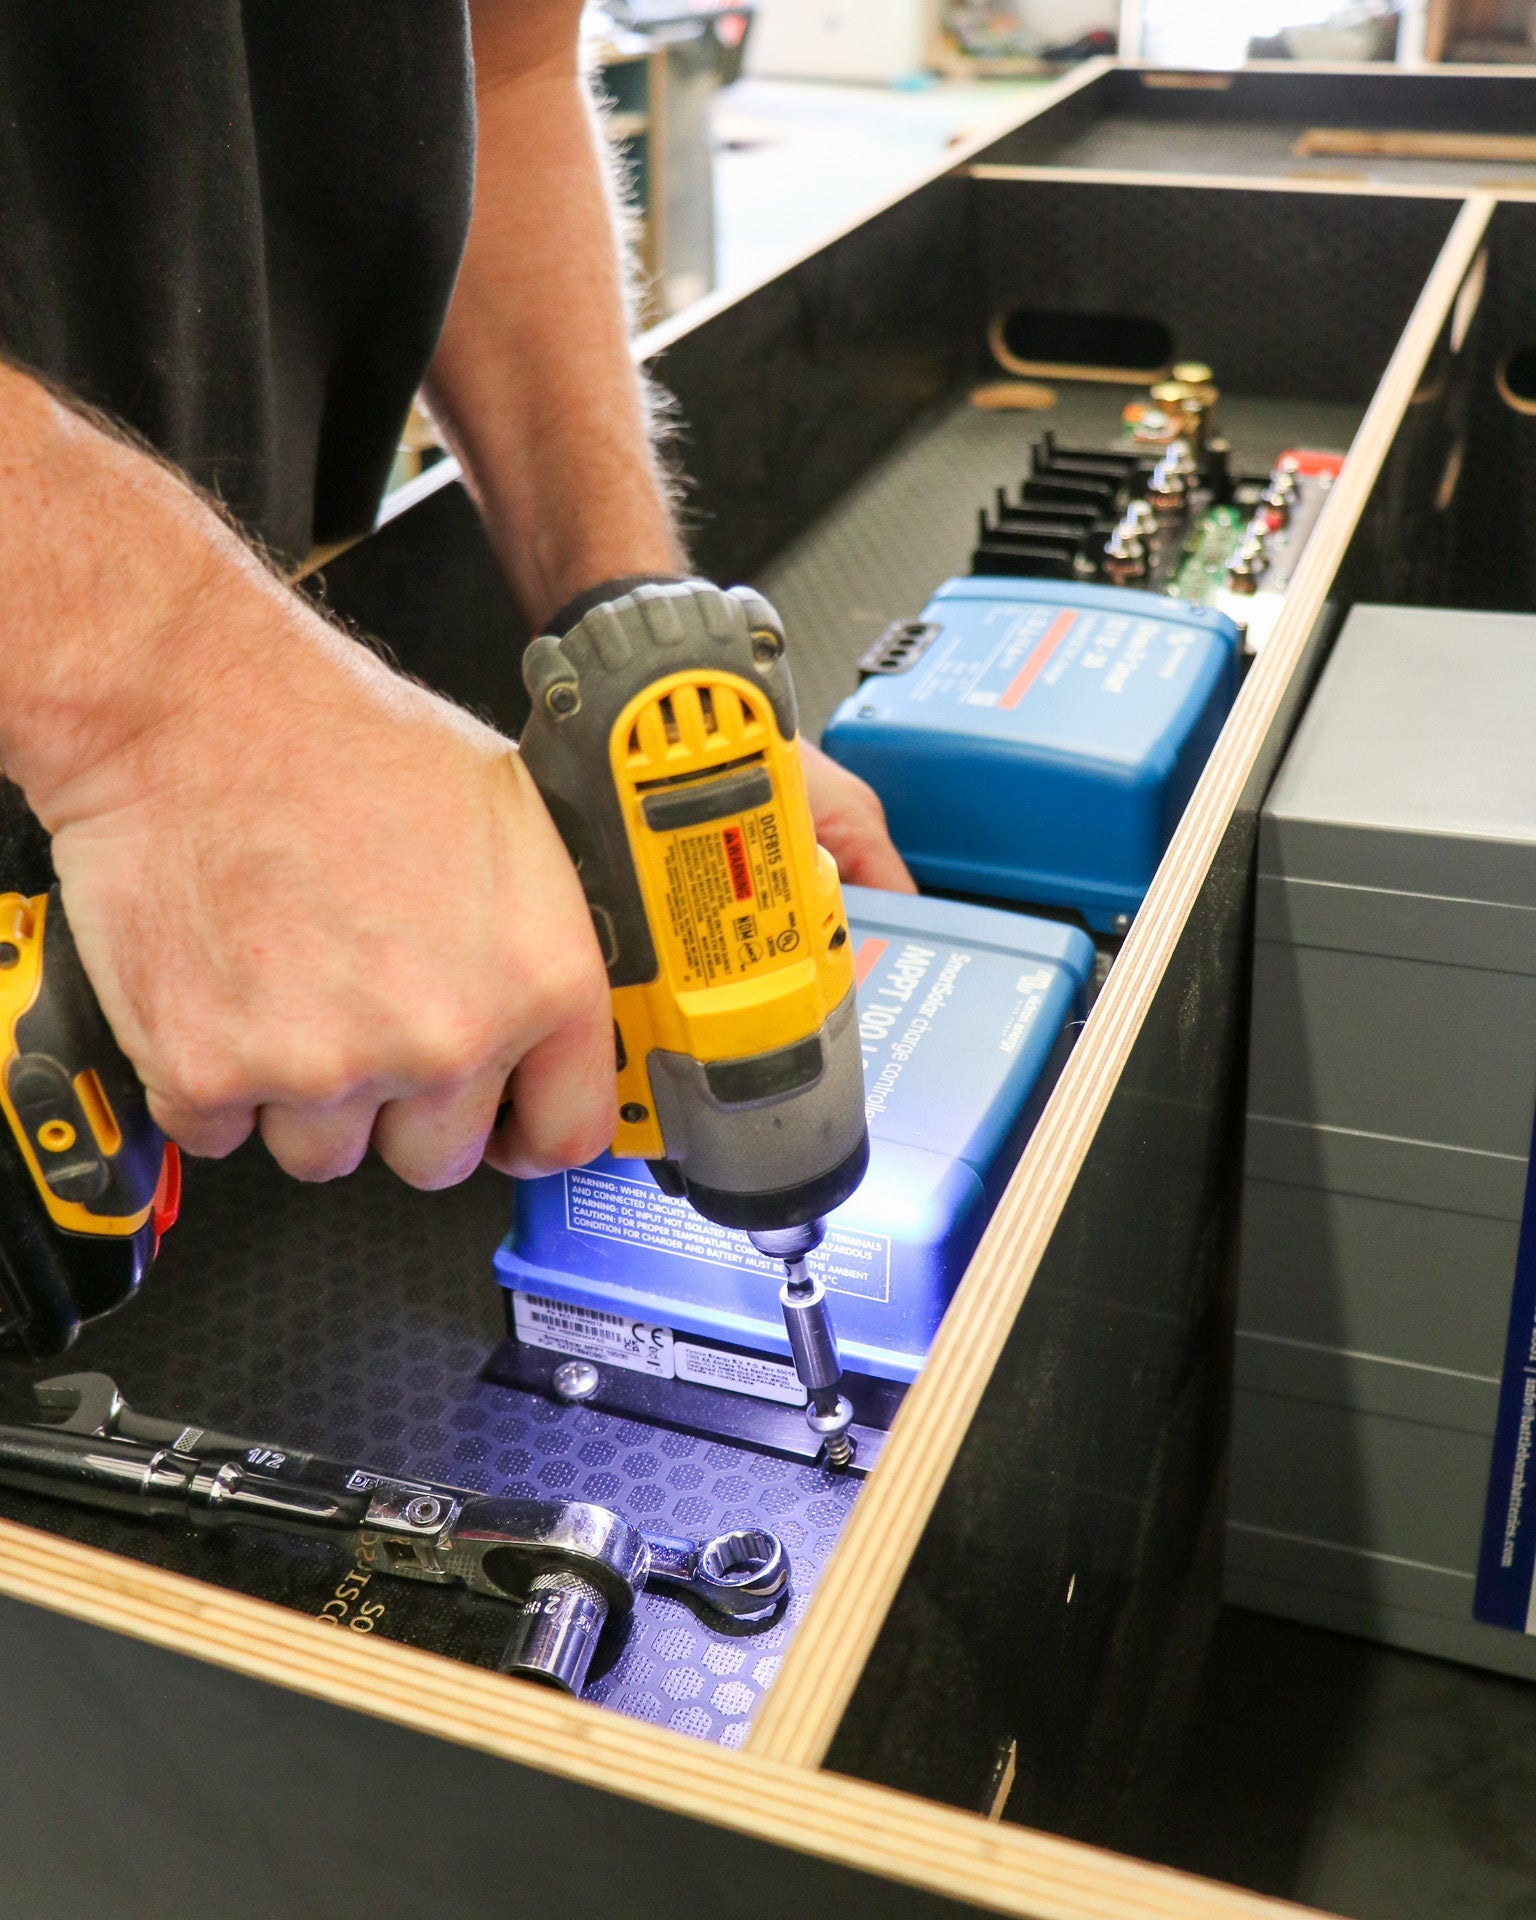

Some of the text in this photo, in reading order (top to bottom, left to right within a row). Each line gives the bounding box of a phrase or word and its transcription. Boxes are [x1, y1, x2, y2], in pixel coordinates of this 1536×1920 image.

[761, 813, 782, 865] DCF815
[728, 844, 752, 900] WARNING
[738, 915, 754, 940] NOM
[878, 944, 937, 1002] MPPT
[918, 953, 971, 1018] SmartSolar
[859, 1003, 903, 1040] 100
[891, 1018, 933, 1062] charge
[1000, 1022, 1025, 1054] energy
[571, 1174, 693, 1209] WARNING: WHEN A GROUN
[572, 1185, 590, 1196] AND
[593, 1190, 644, 1208] CONNECTED
[647, 1203, 685, 1218] CIRCUITS
[572, 1196, 618, 1213] WARNING:
[621, 1207, 633, 1216] DC
[636, 1210, 661, 1223] INPUT
[664, 1217, 681, 1227] NOT
[684, 1222, 725, 1237] ISOLATED
[573, 1206, 616, 1223] CAUTION:
[619, 1217, 634, 1227] FOR
[637, 1221, 669, 1235] PROPER
[671, 1229, 731, 1250] TEMPERATURE
[574, 1216, 783, 1272] CONDITION FOR CHARGER AND BATTERY MUST BE
[831, 1233, 881, 1251] TERMINALS
[808, 1260, 825, 1271] THE
[828, 1265, 868, 1280] AMBIENT
[246, 1446, 286, 1470] 1/2
